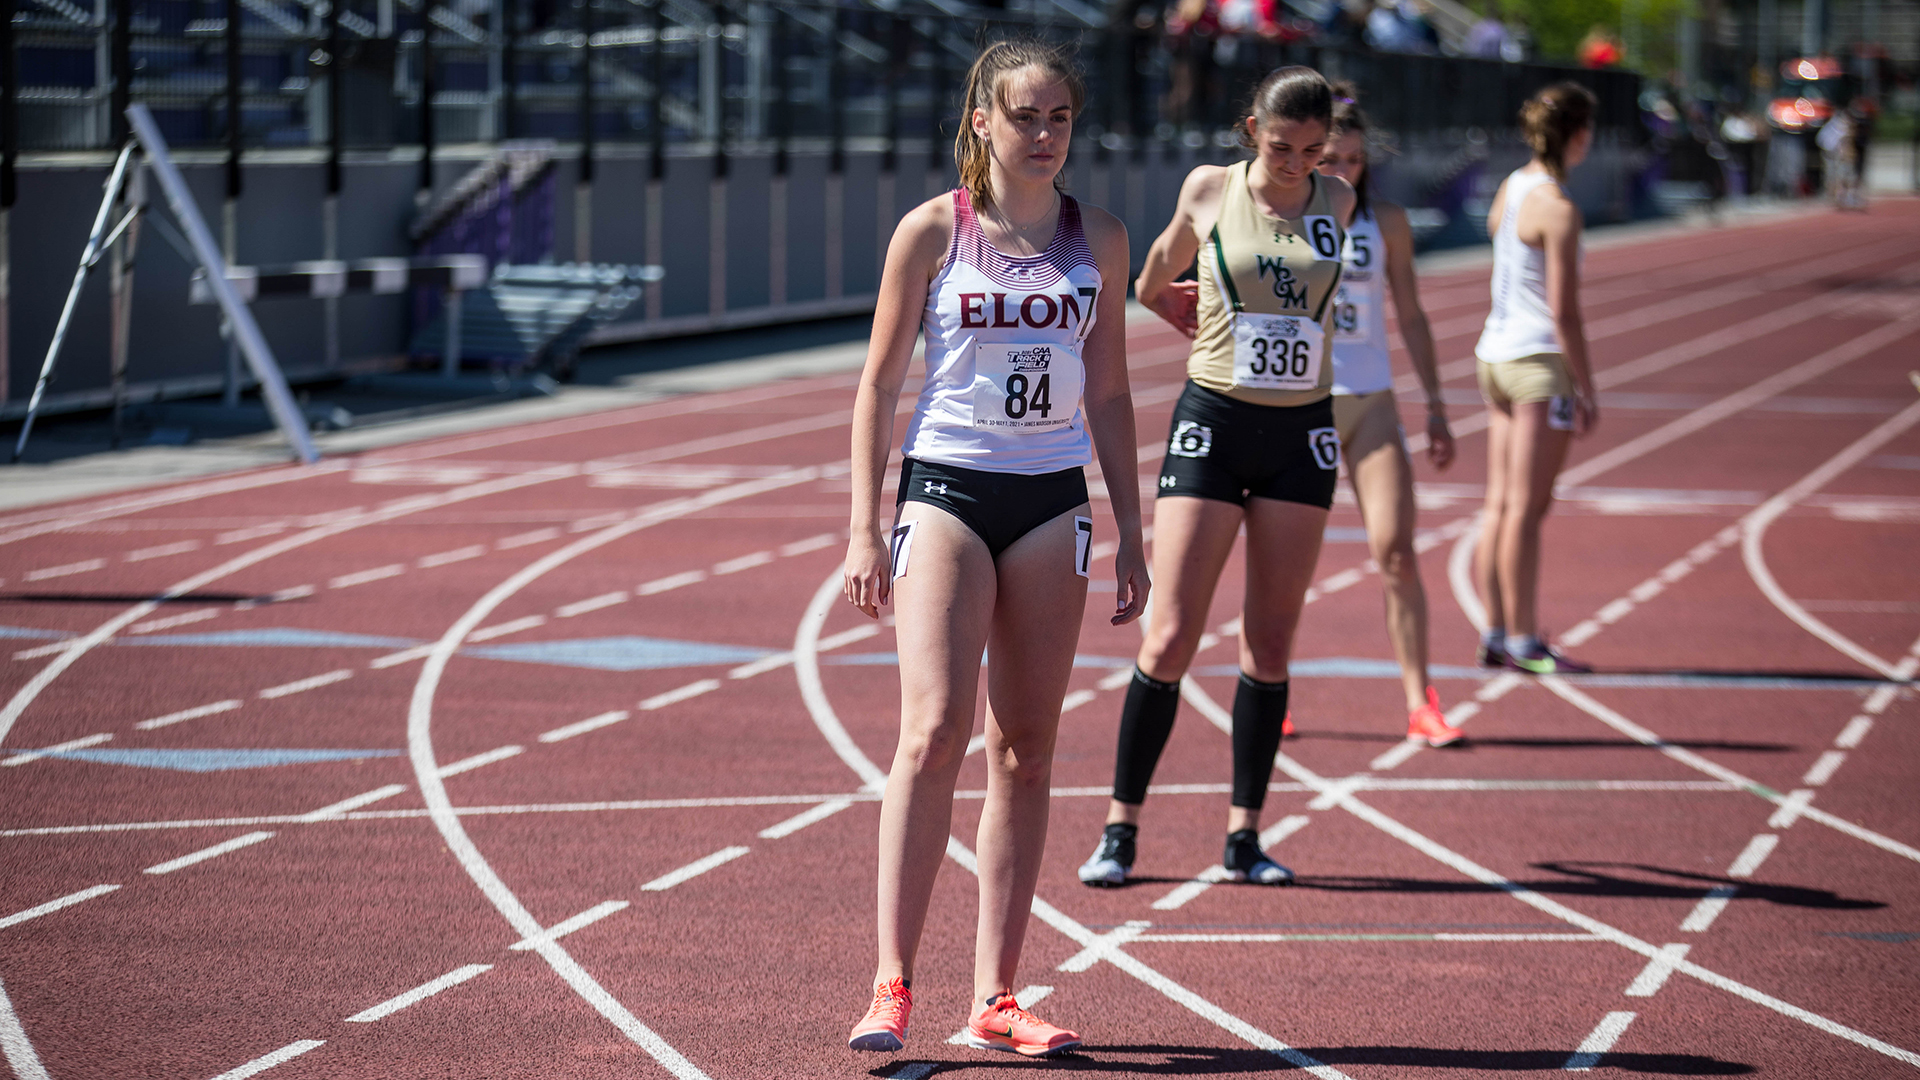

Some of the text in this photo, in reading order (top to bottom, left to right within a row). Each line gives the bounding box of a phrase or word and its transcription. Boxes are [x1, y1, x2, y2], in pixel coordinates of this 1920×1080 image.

[1312, 218, 1336, 258] 6
[1353, 234, 1372, 268] 5
[957, 292, 1081, 330] ELON
[1077, 287, 1097, 337] 7
[1007, 351, 1042, 362] TRACK
[1014, 361, 1046, 371] FIELD
[1032, 346, 1051, 355] CAA
[1251, 337, 1310, 378] 336
[1004, 373, 1052, 420] 84
[1316, 432, 1337, 466] 6
[893, 524, 911, 577] 7
[1078, 520, 1093, 573] 7
